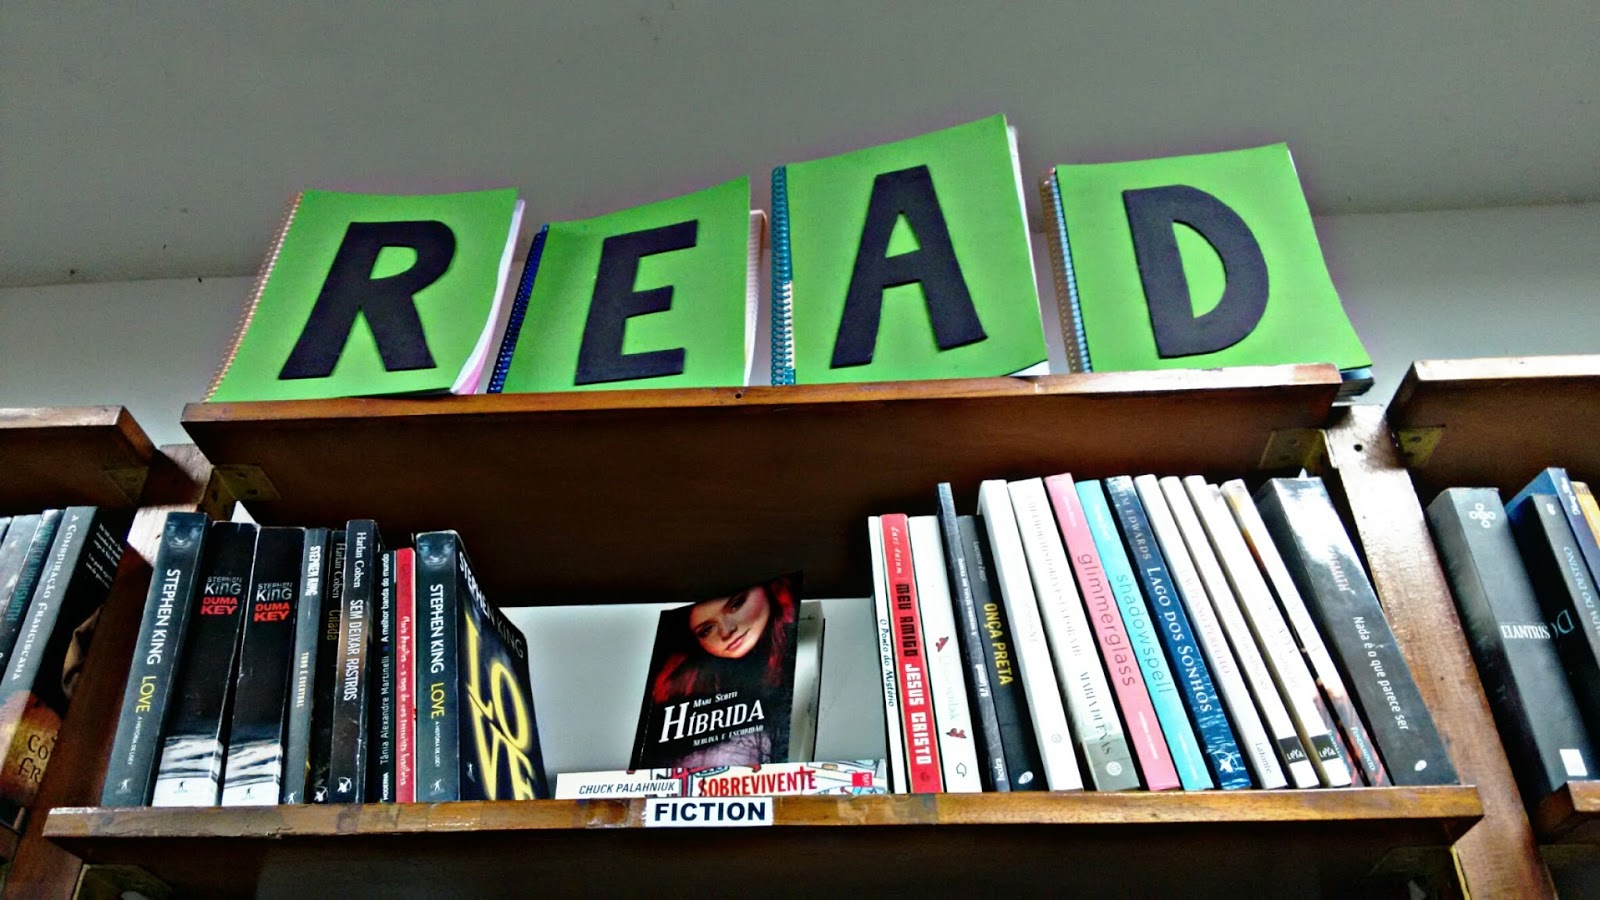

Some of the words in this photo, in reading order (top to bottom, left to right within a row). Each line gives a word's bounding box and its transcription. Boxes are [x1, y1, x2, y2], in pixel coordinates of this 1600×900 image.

[277, 164, 1271, 386] READ
[355, 532, 367, 559] Harlan
[1125, 509, 1152, 560] EDWARDS
[334, 543, 346, 569] Harlan
[381, 553, 389, 577] mundo
[1563, 546, 1588, 590] DESTINO
[207, 576, 242, 584] STEPHEN
[257, 582, 293, 590] STEPHEN
[332, 571, 343, 599] Coben
[353, 560, 365, 588] Coben
[381, 578, 389, 587] do
[155, 569, 181, 627] STEPHEN
[200, 605, 238, 615] KEY
[202, 597, 238, 605] DUMA
[255, 603, 290, 611] DUMA
[349, 599, 364, 620] SEM
[381, 588, 389, 610] banda
[430, 583, 444, 638] STEPHEN
[459, 551, 495, 626] STEPHEN
[497, 615, 523, 659] KING
[896, 583, 912, 610] MEU
[1582, 591, 1595, 608] DO
[253, 611, 290, 622] KEY
[327, 610, 341, 641] Cilada
[381, 610, 389, 635] melhor
[983, 603, 1003, 639] ONÇA
[1077, 553, 1136, 686] glimmerglass
[1116, 574, 1174, 693] shadowspell
[12, 602, 48, 680] FRANCISCANA
[146, 629, 167, 666] KING
[347, 621, 362, 656] DEIXAR
[881, 627, 889, 653] Ponto
[900, 615, 919, 657] AMIGO
[1147, 566, 1171, 606] LAGO
[1163, 611, 1185, 641] DOS
[1178, 645, 1212, 713] SONHOS
[430, 639, 445, 674] KING
[883, 655, 891, 666] do
[992, 642, 1014, 685] PRETA
[1353, 616, 1370, 640] Nada
[1370, 660, 1386, 678] que
[1378, 680, 1401, 712] parece
[1395, 713, 1409, 730] ser
[343, 657, 360, 701] RASTROS
[380, 655, 389, 696] Martinelli
[885, 669, 896, 707] Mistério
[905, 663, 925, 706] JESUS
[1080, 671, 1097, 707] MARIA
[135, 675, 157, 713] LOVE
[431, 682, 445, 719] LOVE
[380, 700, 389, 739] Alexandre
[380, 741, 389, 766] Tânia
[911, 711, 932, 765] CRISTO
[578, 783, 614, 795] CHUCK
[616, 781, 676, 793] PALAHNIUK
[655, 802, 765, 821] FICTION
